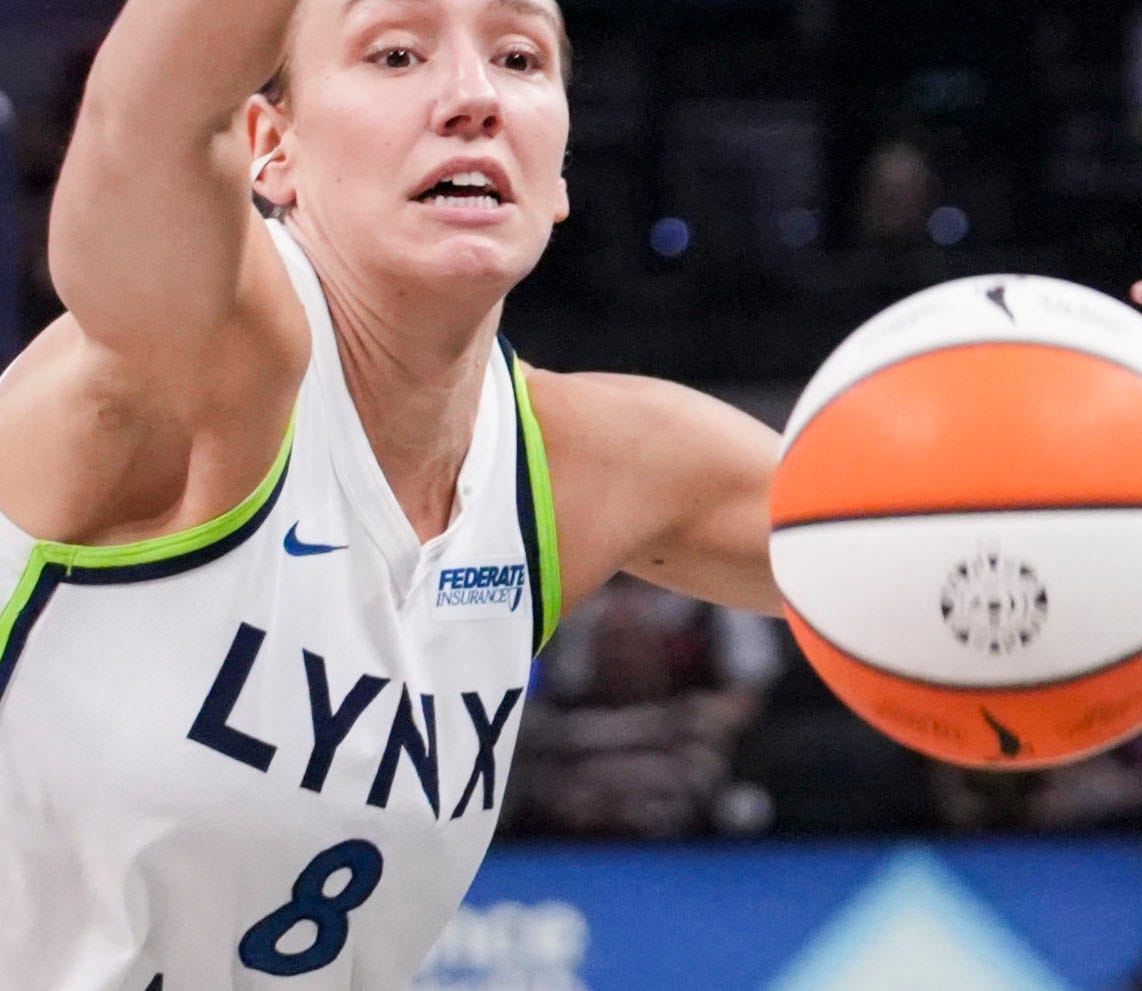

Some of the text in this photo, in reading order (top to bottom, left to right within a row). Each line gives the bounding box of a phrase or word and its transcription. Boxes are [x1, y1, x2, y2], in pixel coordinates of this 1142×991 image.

[436, 589, 508, 608] INSURANCE
[187, 621, 524, 821] LYNX
[238, 839, 384, 977] 8
